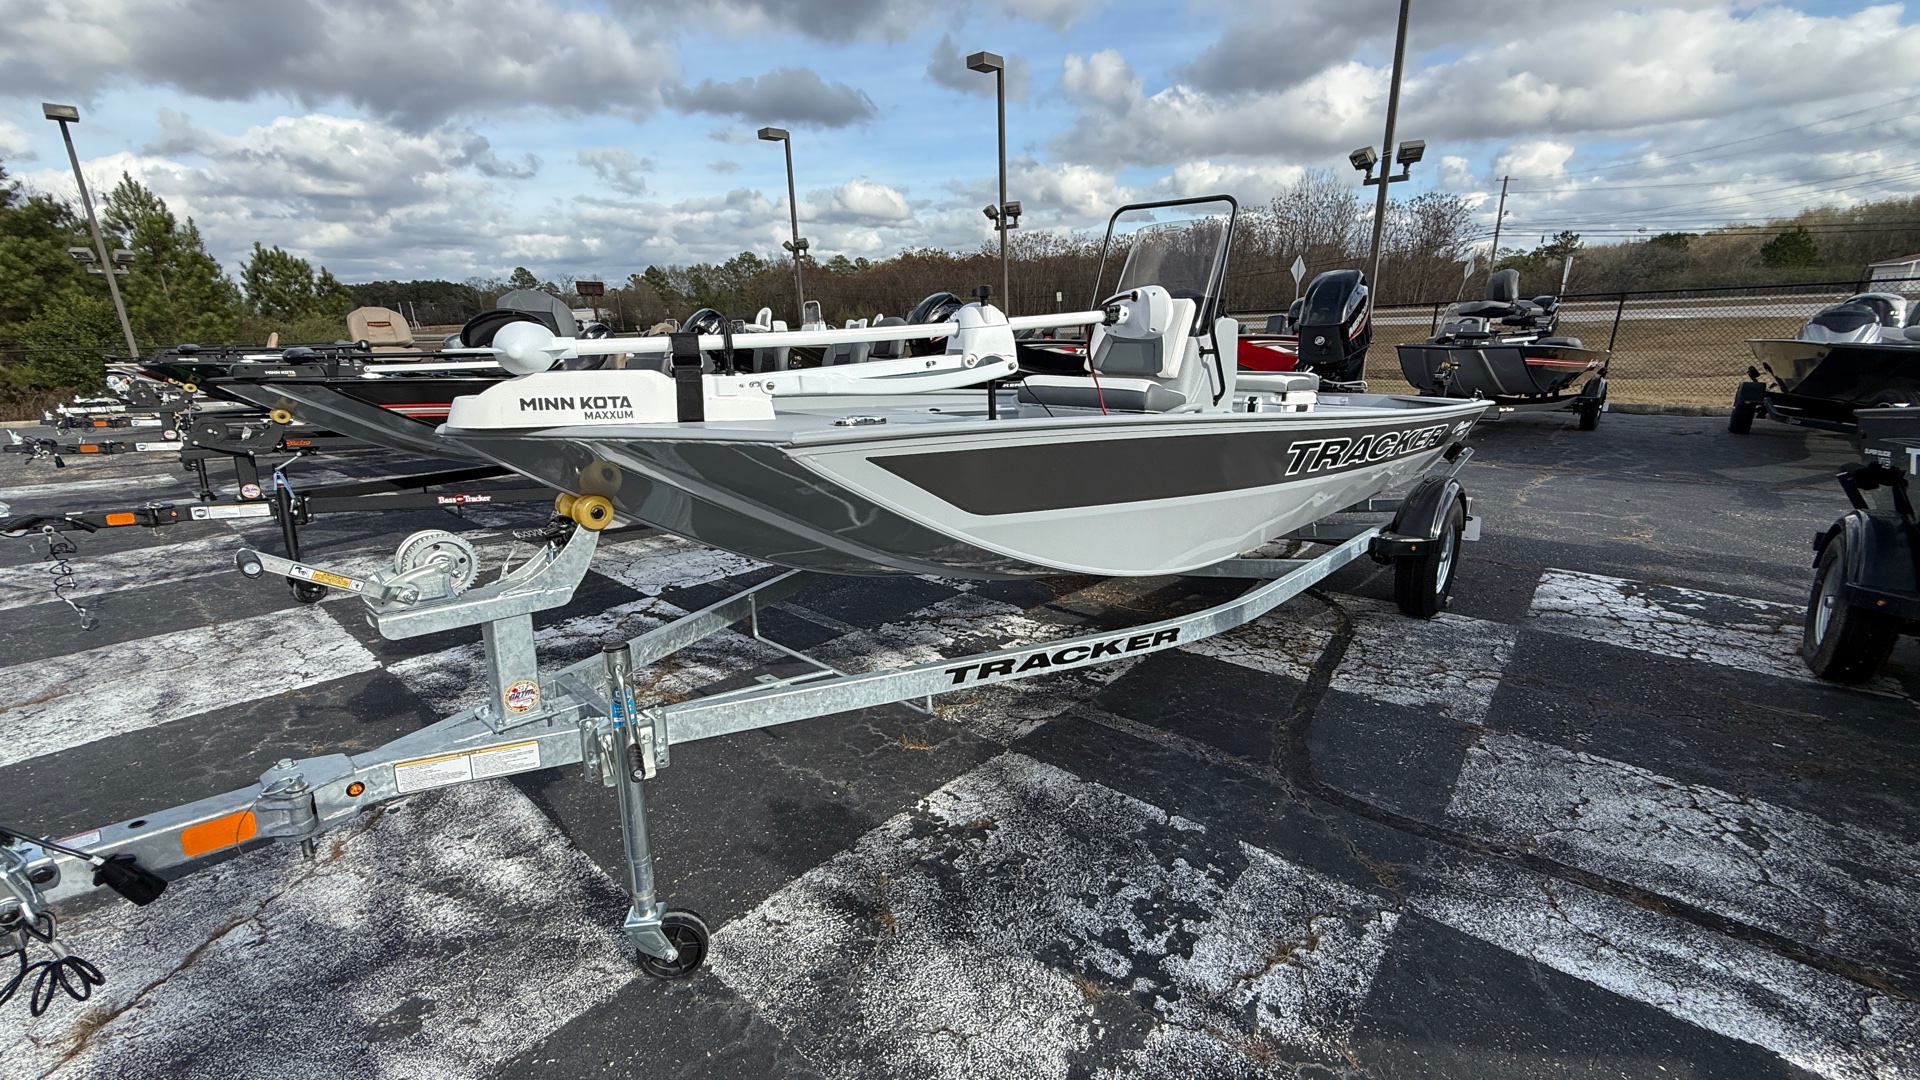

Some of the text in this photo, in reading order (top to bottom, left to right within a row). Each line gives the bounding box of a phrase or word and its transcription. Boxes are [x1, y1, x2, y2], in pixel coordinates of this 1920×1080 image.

[519, 396, 633, 411] MINN KOTA
[584, 410, 634, 420] MAXXUM
[1285, 423, 1449, 476] TRACKER
[438, 494, 491, 504] Bass Tracker
[945, 628, 1181, 684] TRACKER
